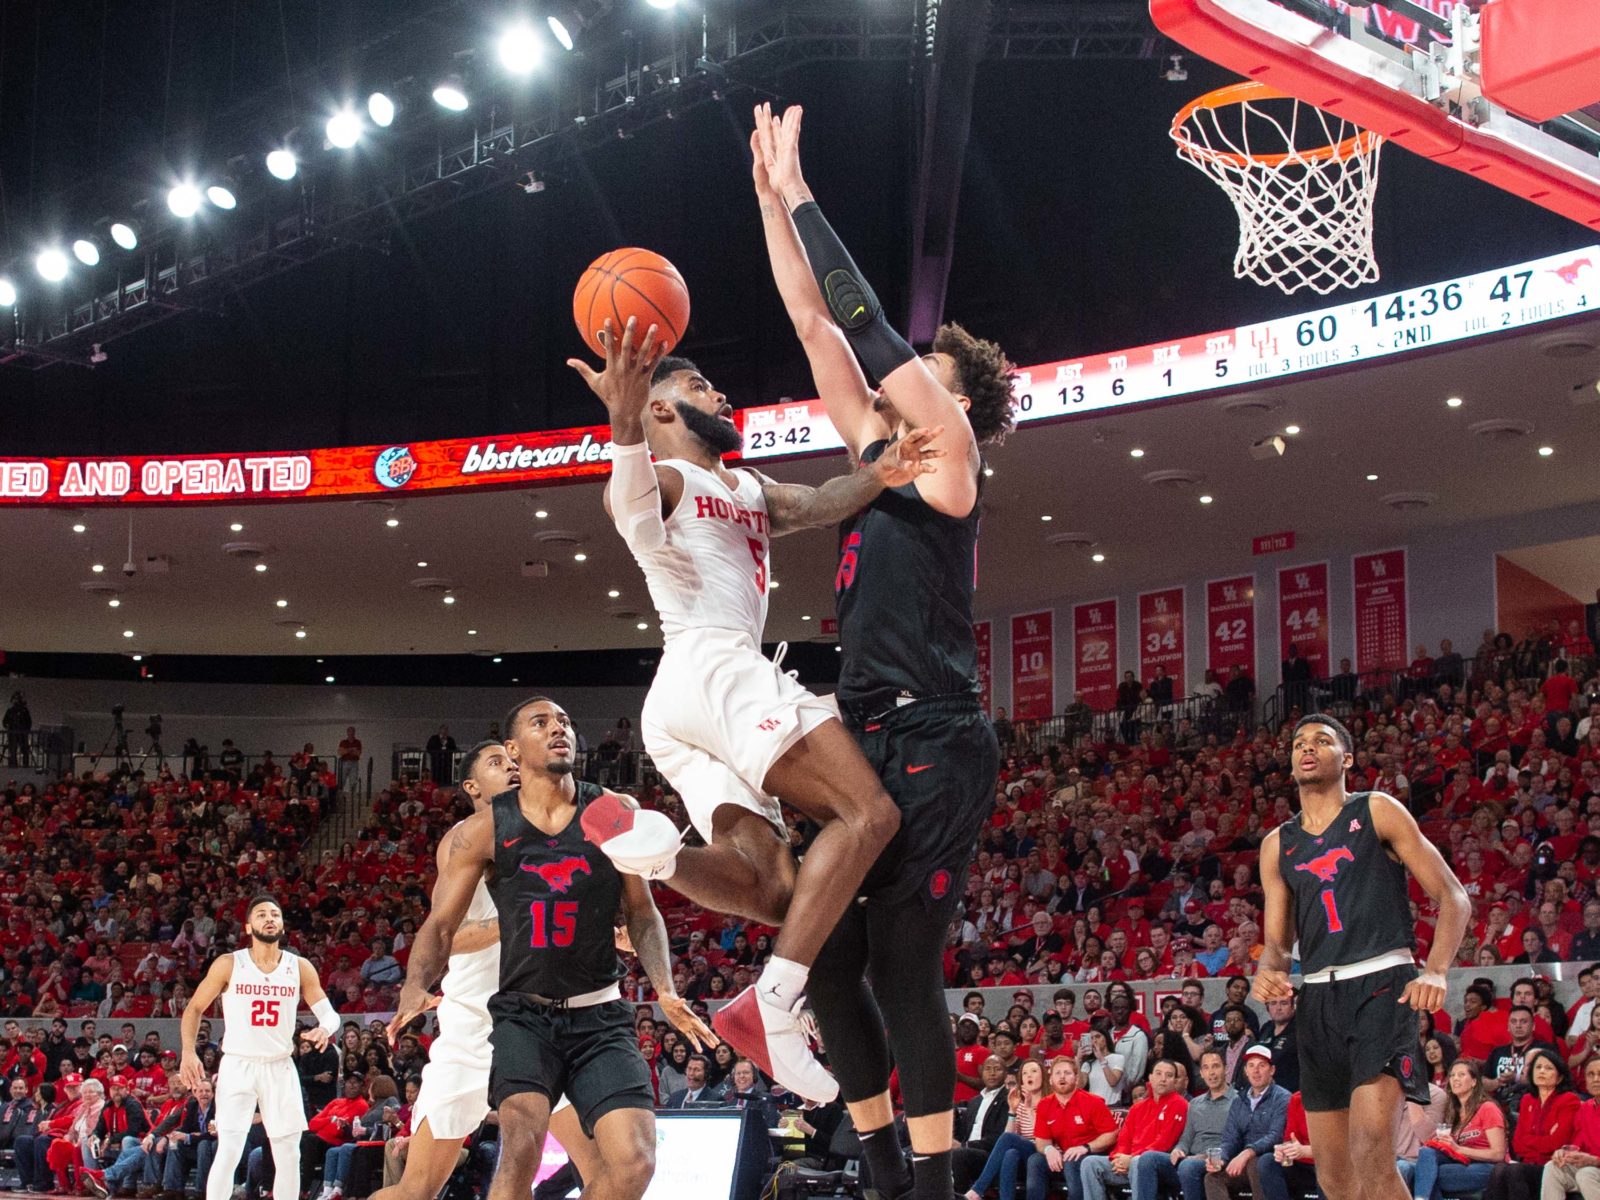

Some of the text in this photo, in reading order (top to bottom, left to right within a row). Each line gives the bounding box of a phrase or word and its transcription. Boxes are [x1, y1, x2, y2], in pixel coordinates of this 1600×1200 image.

[1489, 269, 1534, 303] 47
[1363, 282, 1462, 328] 14:36
[1501, 312, 1511, 326] 2
[1577, 294, 1588, 307] 4
[1296, 315, 1337, 347] 60
[1394, 324, 1432, 348] 2ND
[1215, 358, 1229, 378] 5
[1281, 358, 1291, 372] 3
[1350, 344, 1360, 358] 3
[1112, 378, 1126, 396] 6
[1162, 369, 1173, 387] 1
[1058, 385, 1085, 405] 13
[751, 426, 811, 450] 23-42
[60, 461, 131, 497] AND
[141, 456, 310, 496] OPERATED
[695, 496, 771, 537] HOUST
[745, 535, 767, 597] 5
[1215, 618, 1247, 642] 42
[1286, 607, 1321, 631] 44
[1082, 641, 1110, 664] 22
[1146, 629, 1177, 653] 34
[1020, 651, 1044, 673] 10
[1321, 889, 1344, 934] 1
[529, 900, 579, 948] 15
[235, 983, 297, 998] HOUSTON
[251, 1000, 281, 1027] 25
